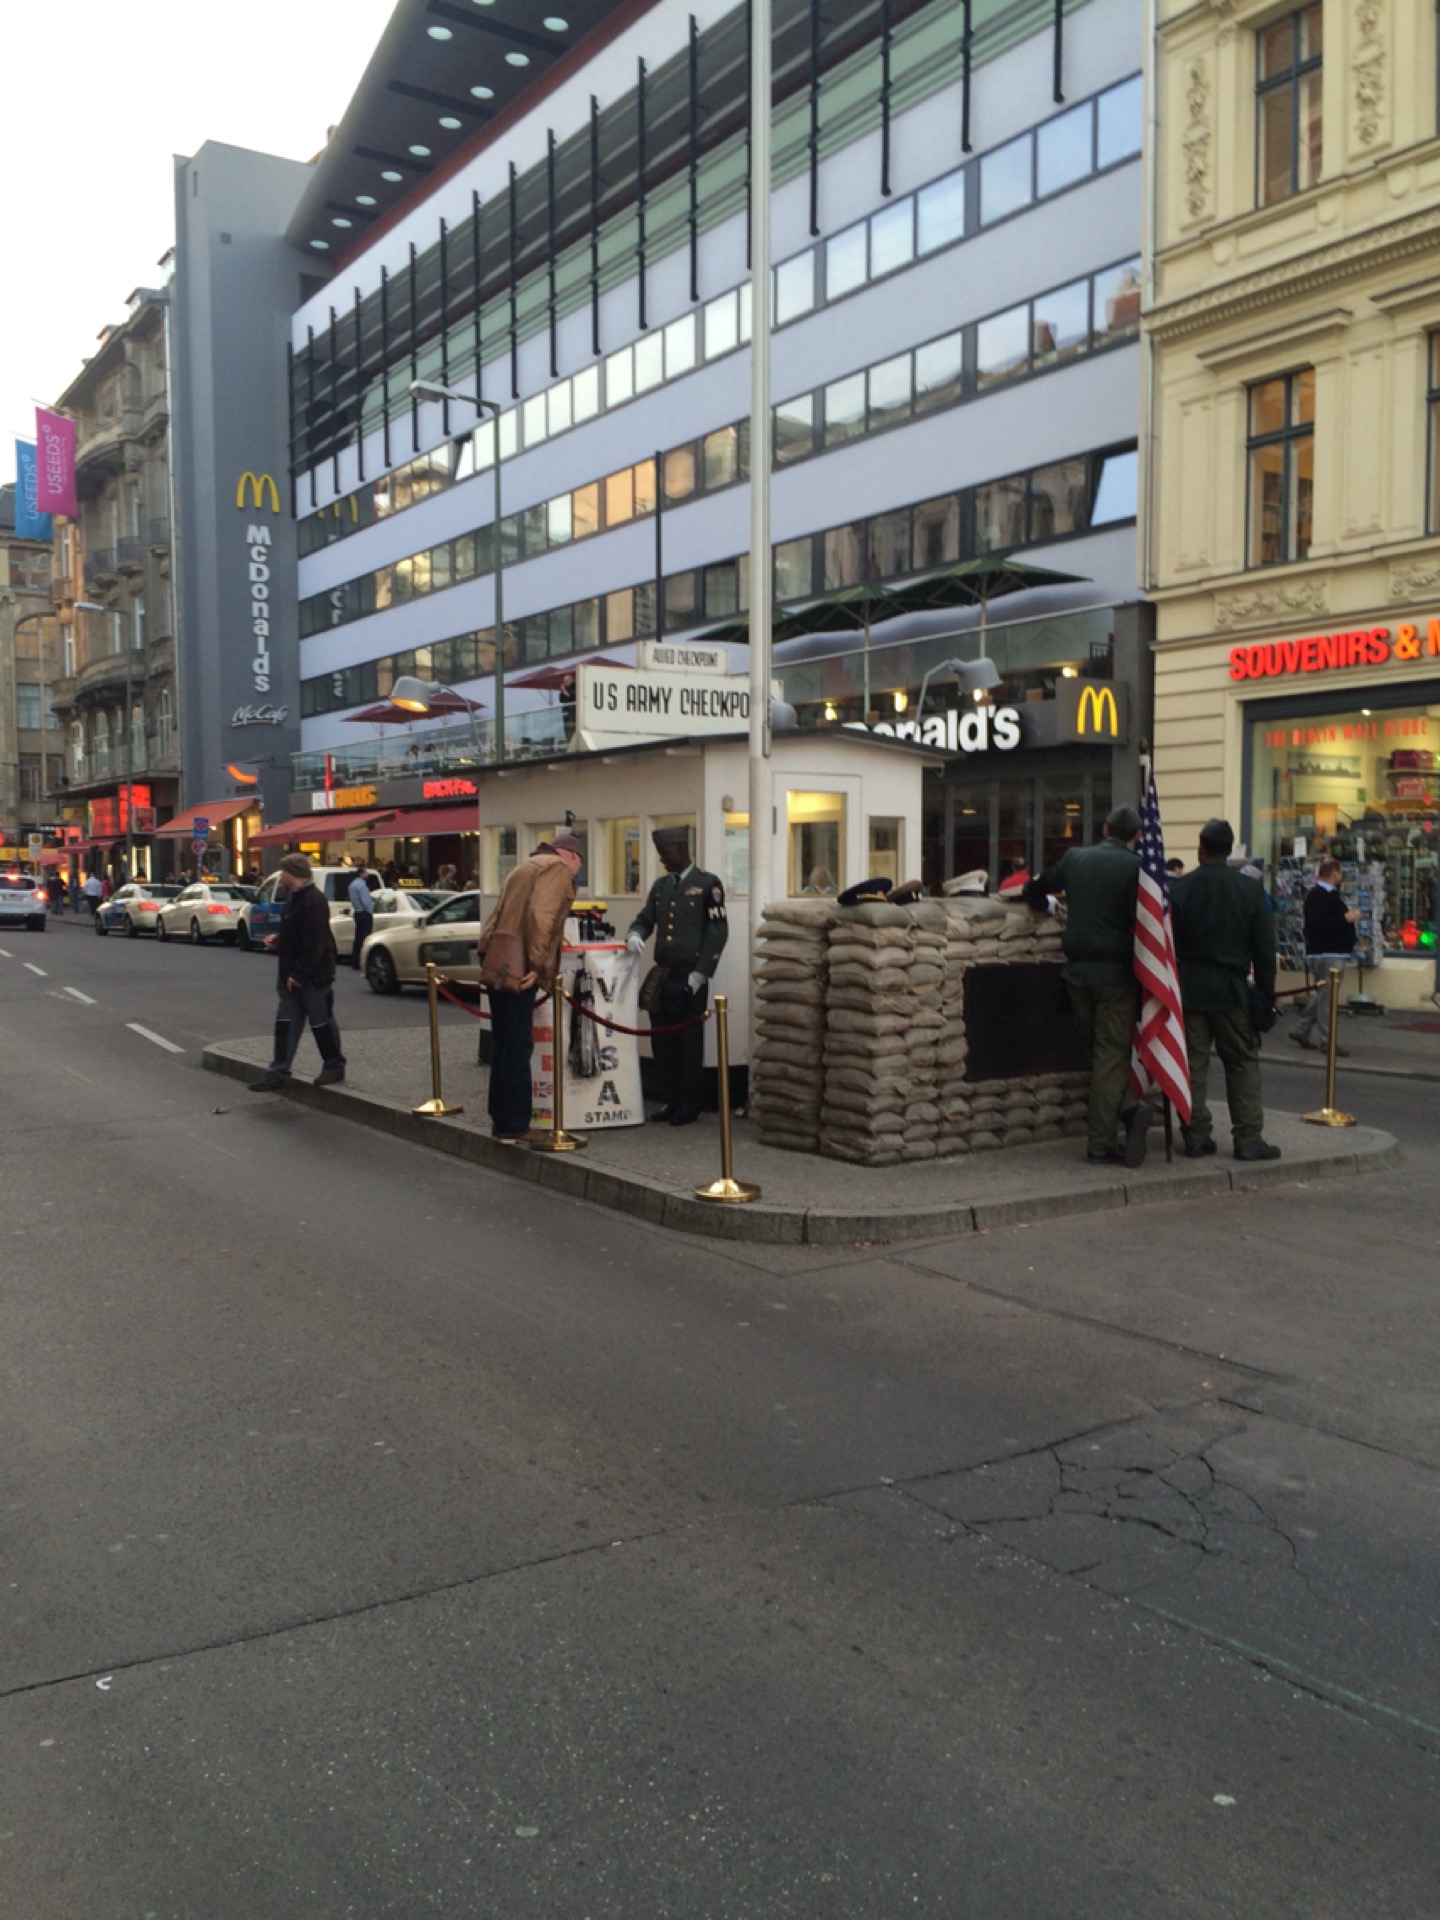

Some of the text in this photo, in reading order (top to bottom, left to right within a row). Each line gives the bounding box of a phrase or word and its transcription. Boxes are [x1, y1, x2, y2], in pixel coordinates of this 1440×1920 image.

[652, 648, 719, 667] ALLIED CHECKPOINT
[1229, 628, 1389, 680] SOUVENIRS
[1394, 623, 1420, 660] &
[626, 684, 673, 714] ARMY
[680, 688, 749, 719] CHECKPO
[1293, 728, 1336, 745] BERLIN
[1343, 724, 1376, 740] WALL
[1386, 719, 1427, 736] STORE
[584, 1109, 633, 1124] STAMP
